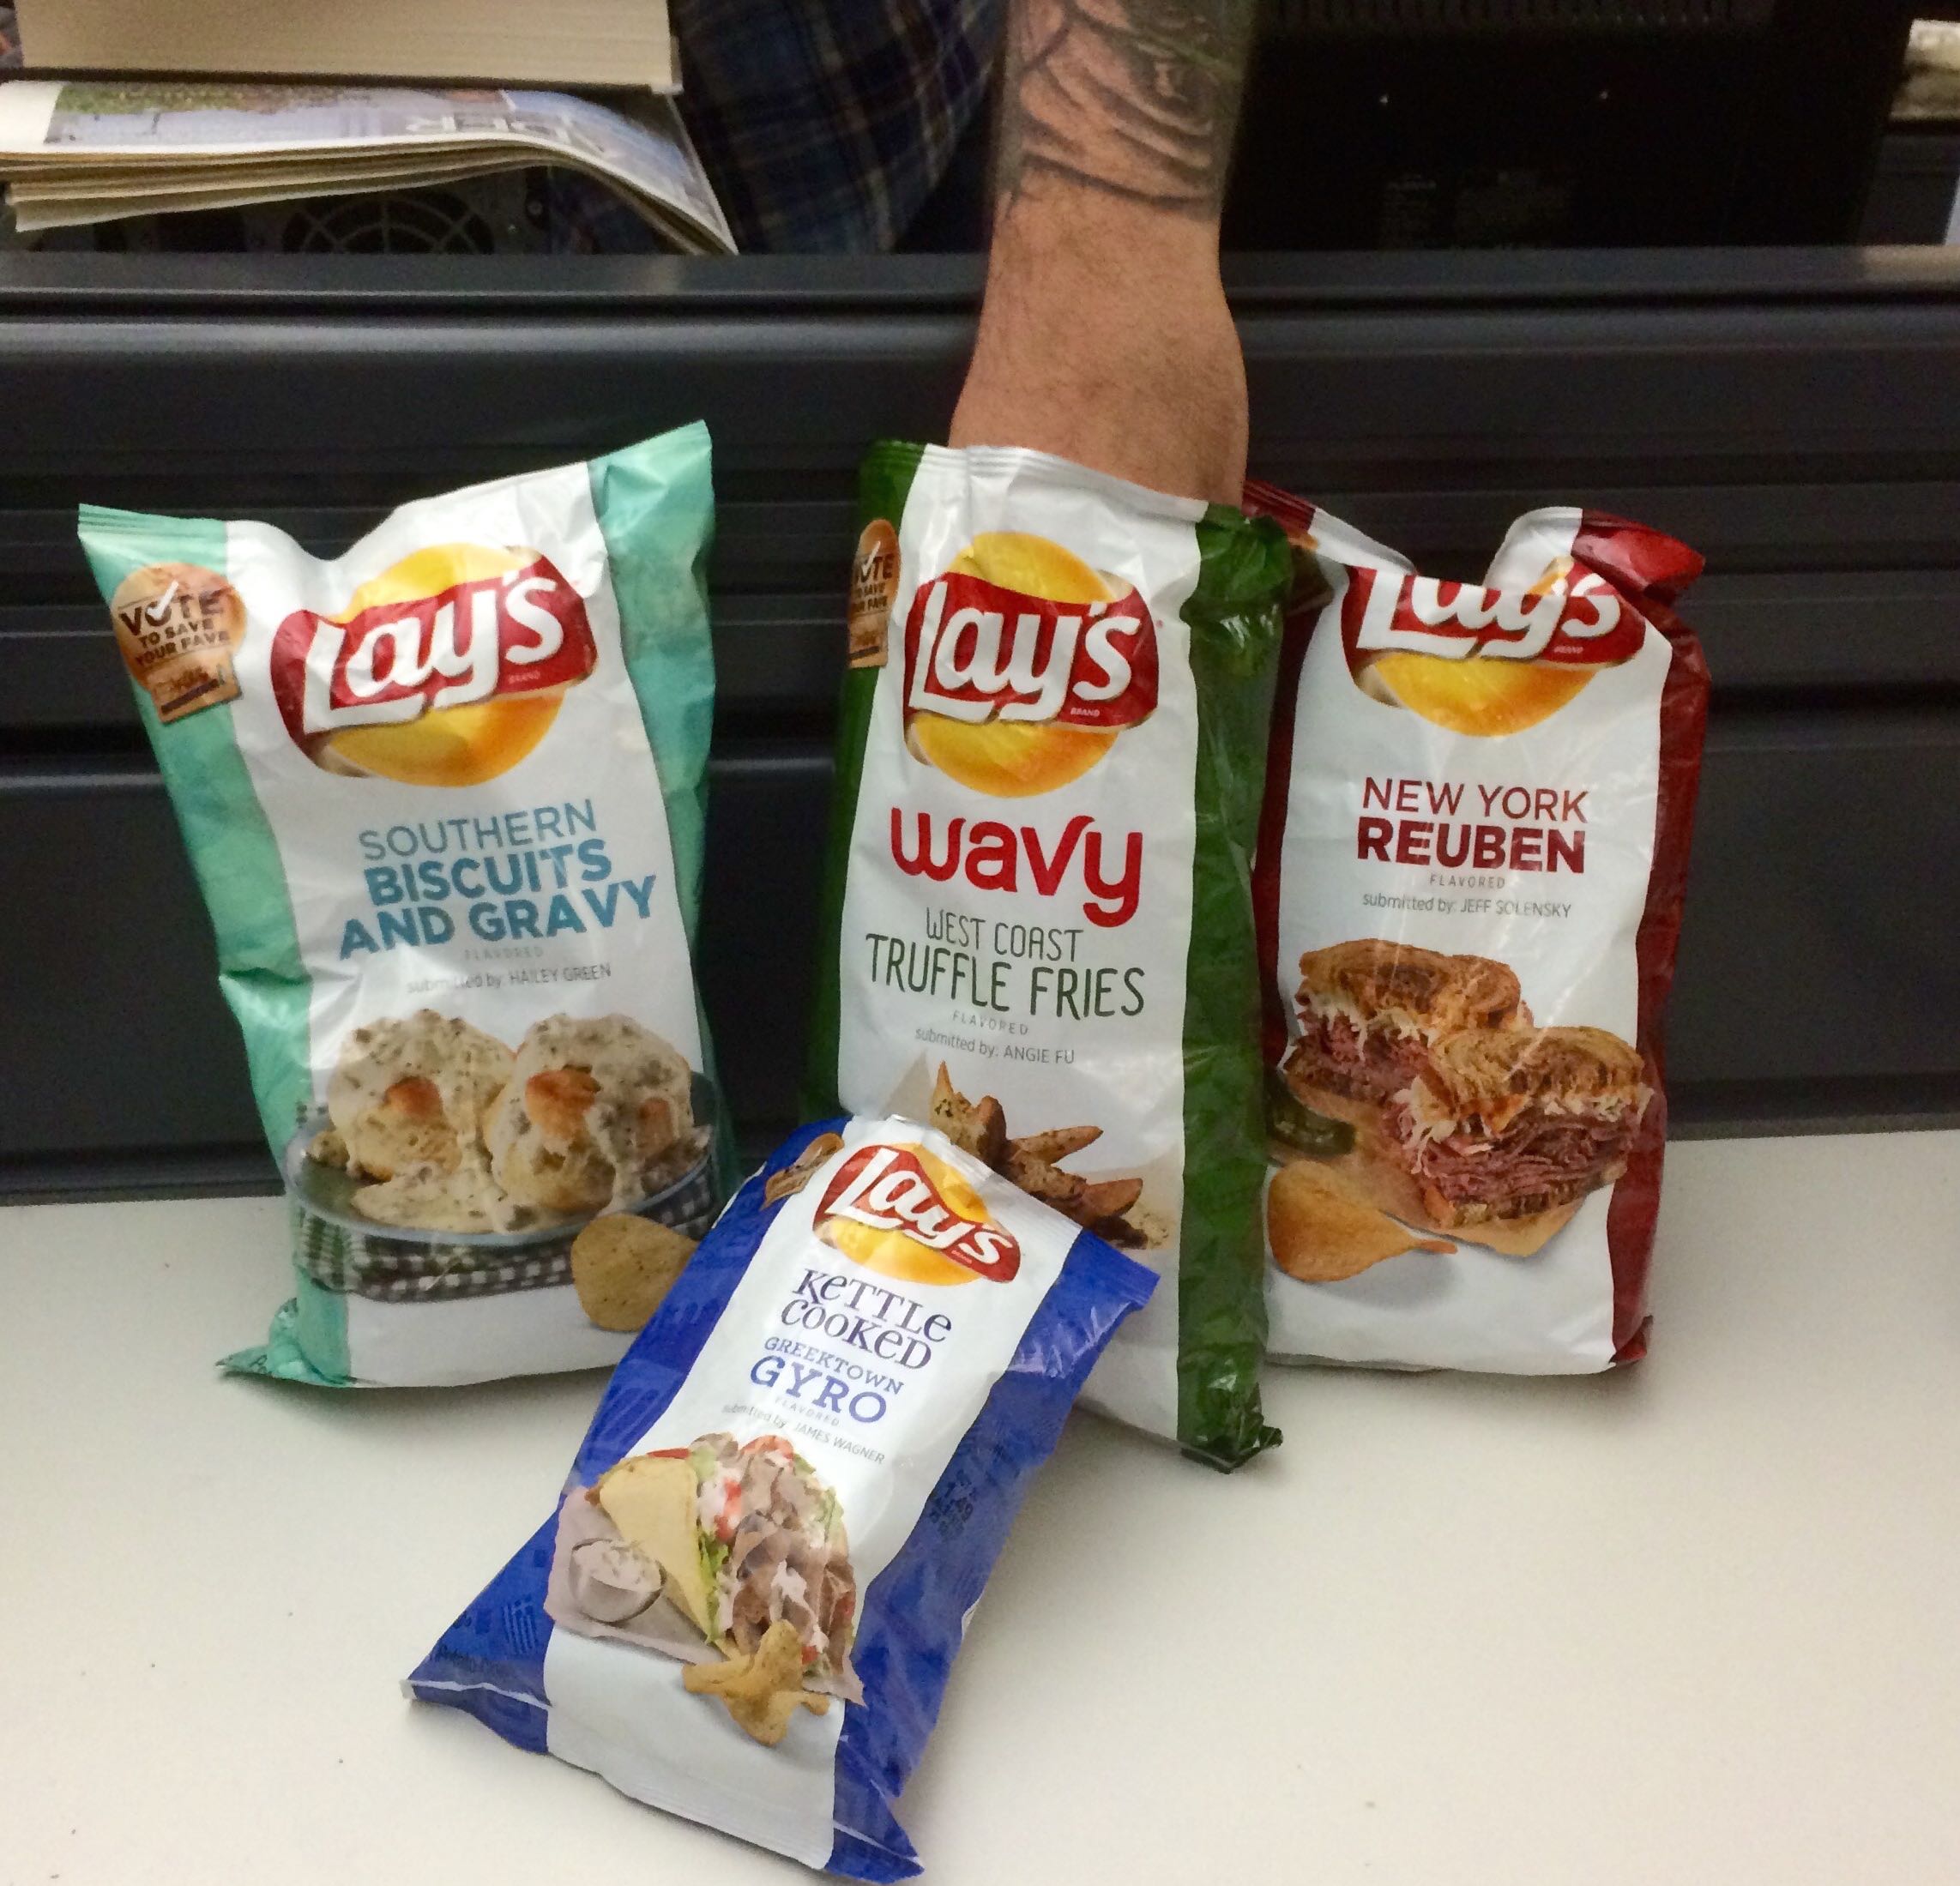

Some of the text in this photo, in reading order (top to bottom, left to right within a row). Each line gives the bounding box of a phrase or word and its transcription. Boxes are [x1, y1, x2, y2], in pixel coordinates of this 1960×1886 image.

[118, 588, 226, 636] VOTE
[137, 618, 214, 648] TO SAVE
[135, 642, 177, 666] YOUR
[302, 569, 564, 735] Lay's
[908, 581, 1140, 722] Lay's
[1362, 776, 1589, 824] NEW YORK
[357, 798, 598, 861] SOUTHERN
[1357, 816, 1585, 874] REUBEN
[364, 837, 612, 907] BISCUITS
[890, 807, 1143, 928] wavy
[1429, 873, 1506, 889] FLAVORED
[339, 875, 657, 961] AND GRAVY
[1362, 891, 1433, 912] submitted
[1460, 898, 1492, 913] JEFF
[1496, 899, 1572, 919] SOLENSKY
[926, 907, 1084, 962] WEST COAST
[563, 962, 612, 982] GREEN
[865, 933, 1146, 1021] TRUFFLE FRIES
[915, 1027, 975, 1052] submitted
[1003, 1045, 1050, 1064] ANGIE
[1055, 1049, 1075, 1064] FU
[952, 1010, 1028, 1035] FLAVORED
[750, 1354, 887, 1425] GYRO
[763, 1335, 905, 1396] GREEKTOWN
[833, 1436, 885, 1465] WAGNER
